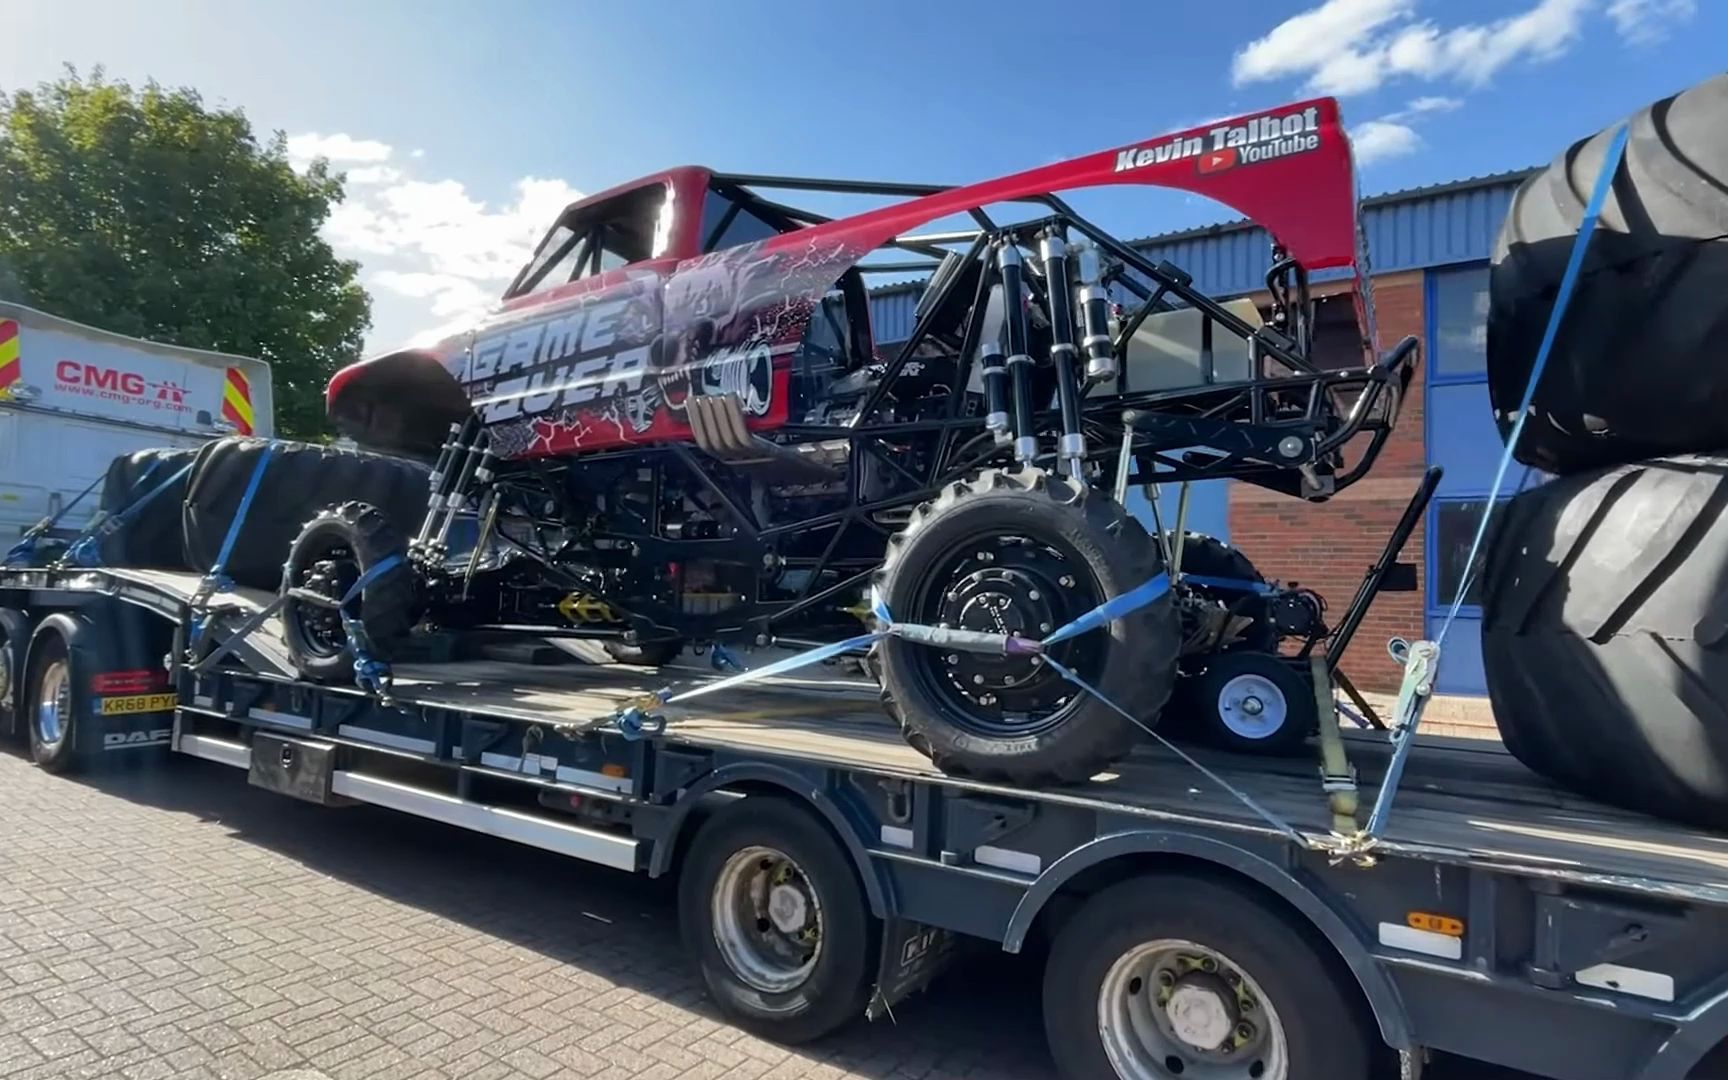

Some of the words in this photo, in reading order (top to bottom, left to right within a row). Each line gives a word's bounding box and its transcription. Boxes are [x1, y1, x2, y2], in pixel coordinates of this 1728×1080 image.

[1115, 136, 1203, 173] Kevin
[1210, 107, 1319, 151] Talbot
[1240, 134, 1319, 165] YouTube
[461, 299, 630, 384] GAME
[56, 360, 145, 396] CMG
[484, 345, 651, 425] OVER
[54, 383, 193, 413] www.cmg-org.com
[103, 697, 146, 713] KR68
[104, 729, 172, 745] DAF
